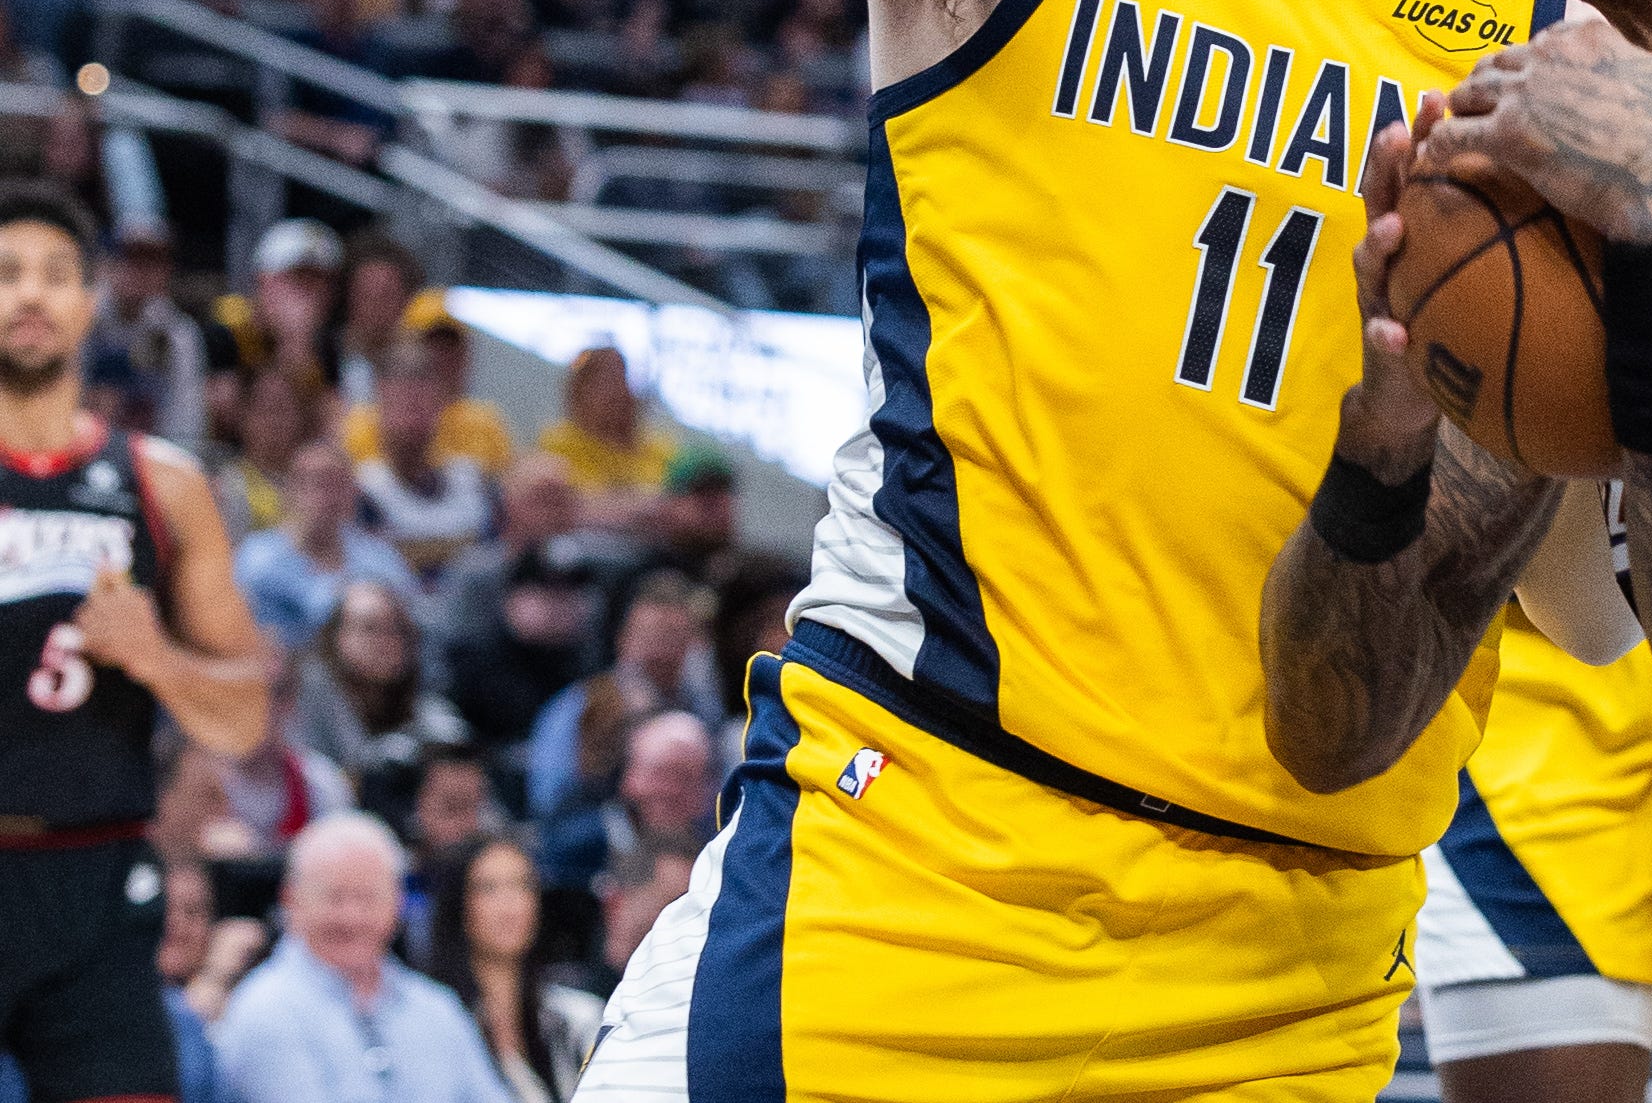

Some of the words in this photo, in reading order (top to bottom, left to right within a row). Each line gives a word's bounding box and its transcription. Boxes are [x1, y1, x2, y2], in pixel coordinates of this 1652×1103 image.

[1478, 19, 1516, 46] OIL
[1173, 183, 1326, 413] 11
[26, 620, 96, 713] 5
